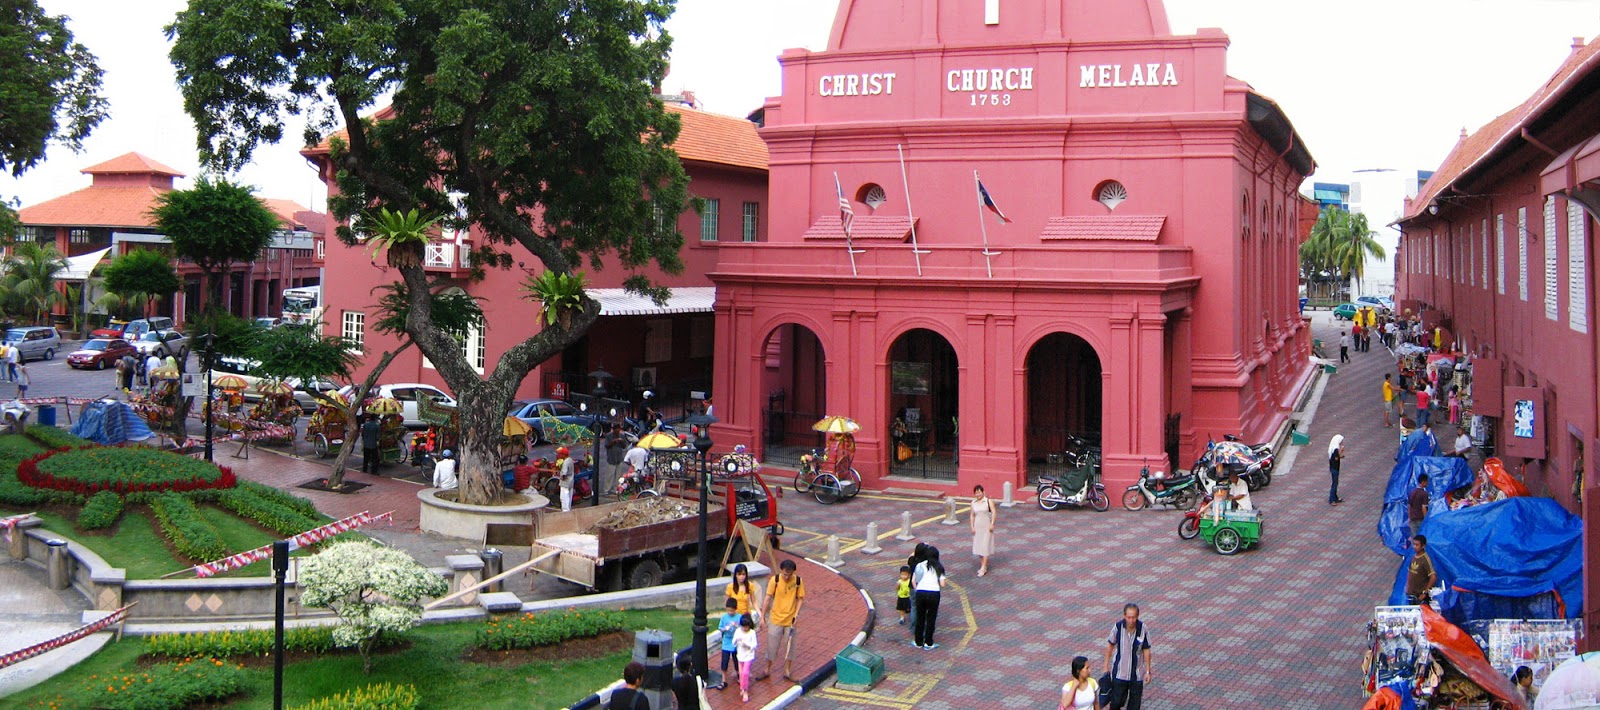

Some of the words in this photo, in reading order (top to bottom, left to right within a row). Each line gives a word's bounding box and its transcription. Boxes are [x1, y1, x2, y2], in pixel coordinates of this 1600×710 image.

[819, 72, 896, 98] CHRIST
[947, 67, 1034, 92] CHURCH
[1079, 62, 1178, 88] MELAKA
[970, 93, 1012, 107] 1753
